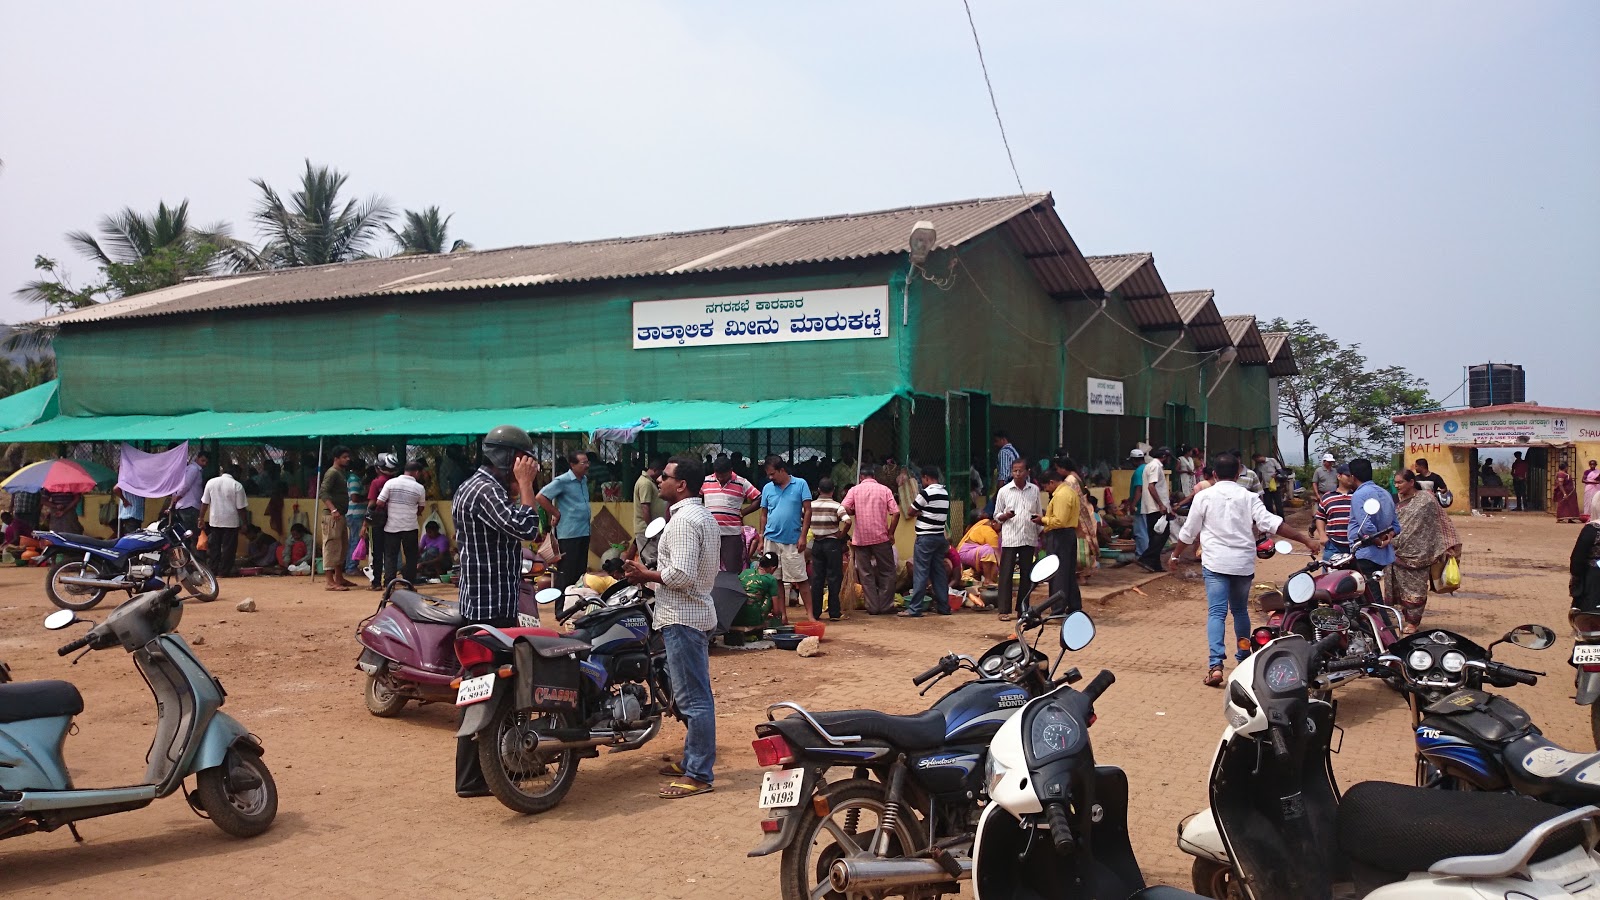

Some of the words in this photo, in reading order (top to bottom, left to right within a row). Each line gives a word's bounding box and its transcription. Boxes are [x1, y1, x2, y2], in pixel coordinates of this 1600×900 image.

[705, 299, 750, 313] ನಗರಸಭೆ
[755, 297, 804, 311] ಕಾರವಾರ
[637, 319, 714, 344] ತಾತ್ಕಾಲಿಕ
[724, 315, 779, 337] ಮೀನು
[790, 308, 881, 335] ಮಾರುಕಟ್ಟೆ
[1410, 441, 1441, 454] BATH
[999, 693, 1025, 702] HERO
[998, 699, 1028, 708] HONDA
[1422, 729, 1441, 739] TVS
[768, 782, 780, 792] KA
[782, 781, 794, 790] 30
